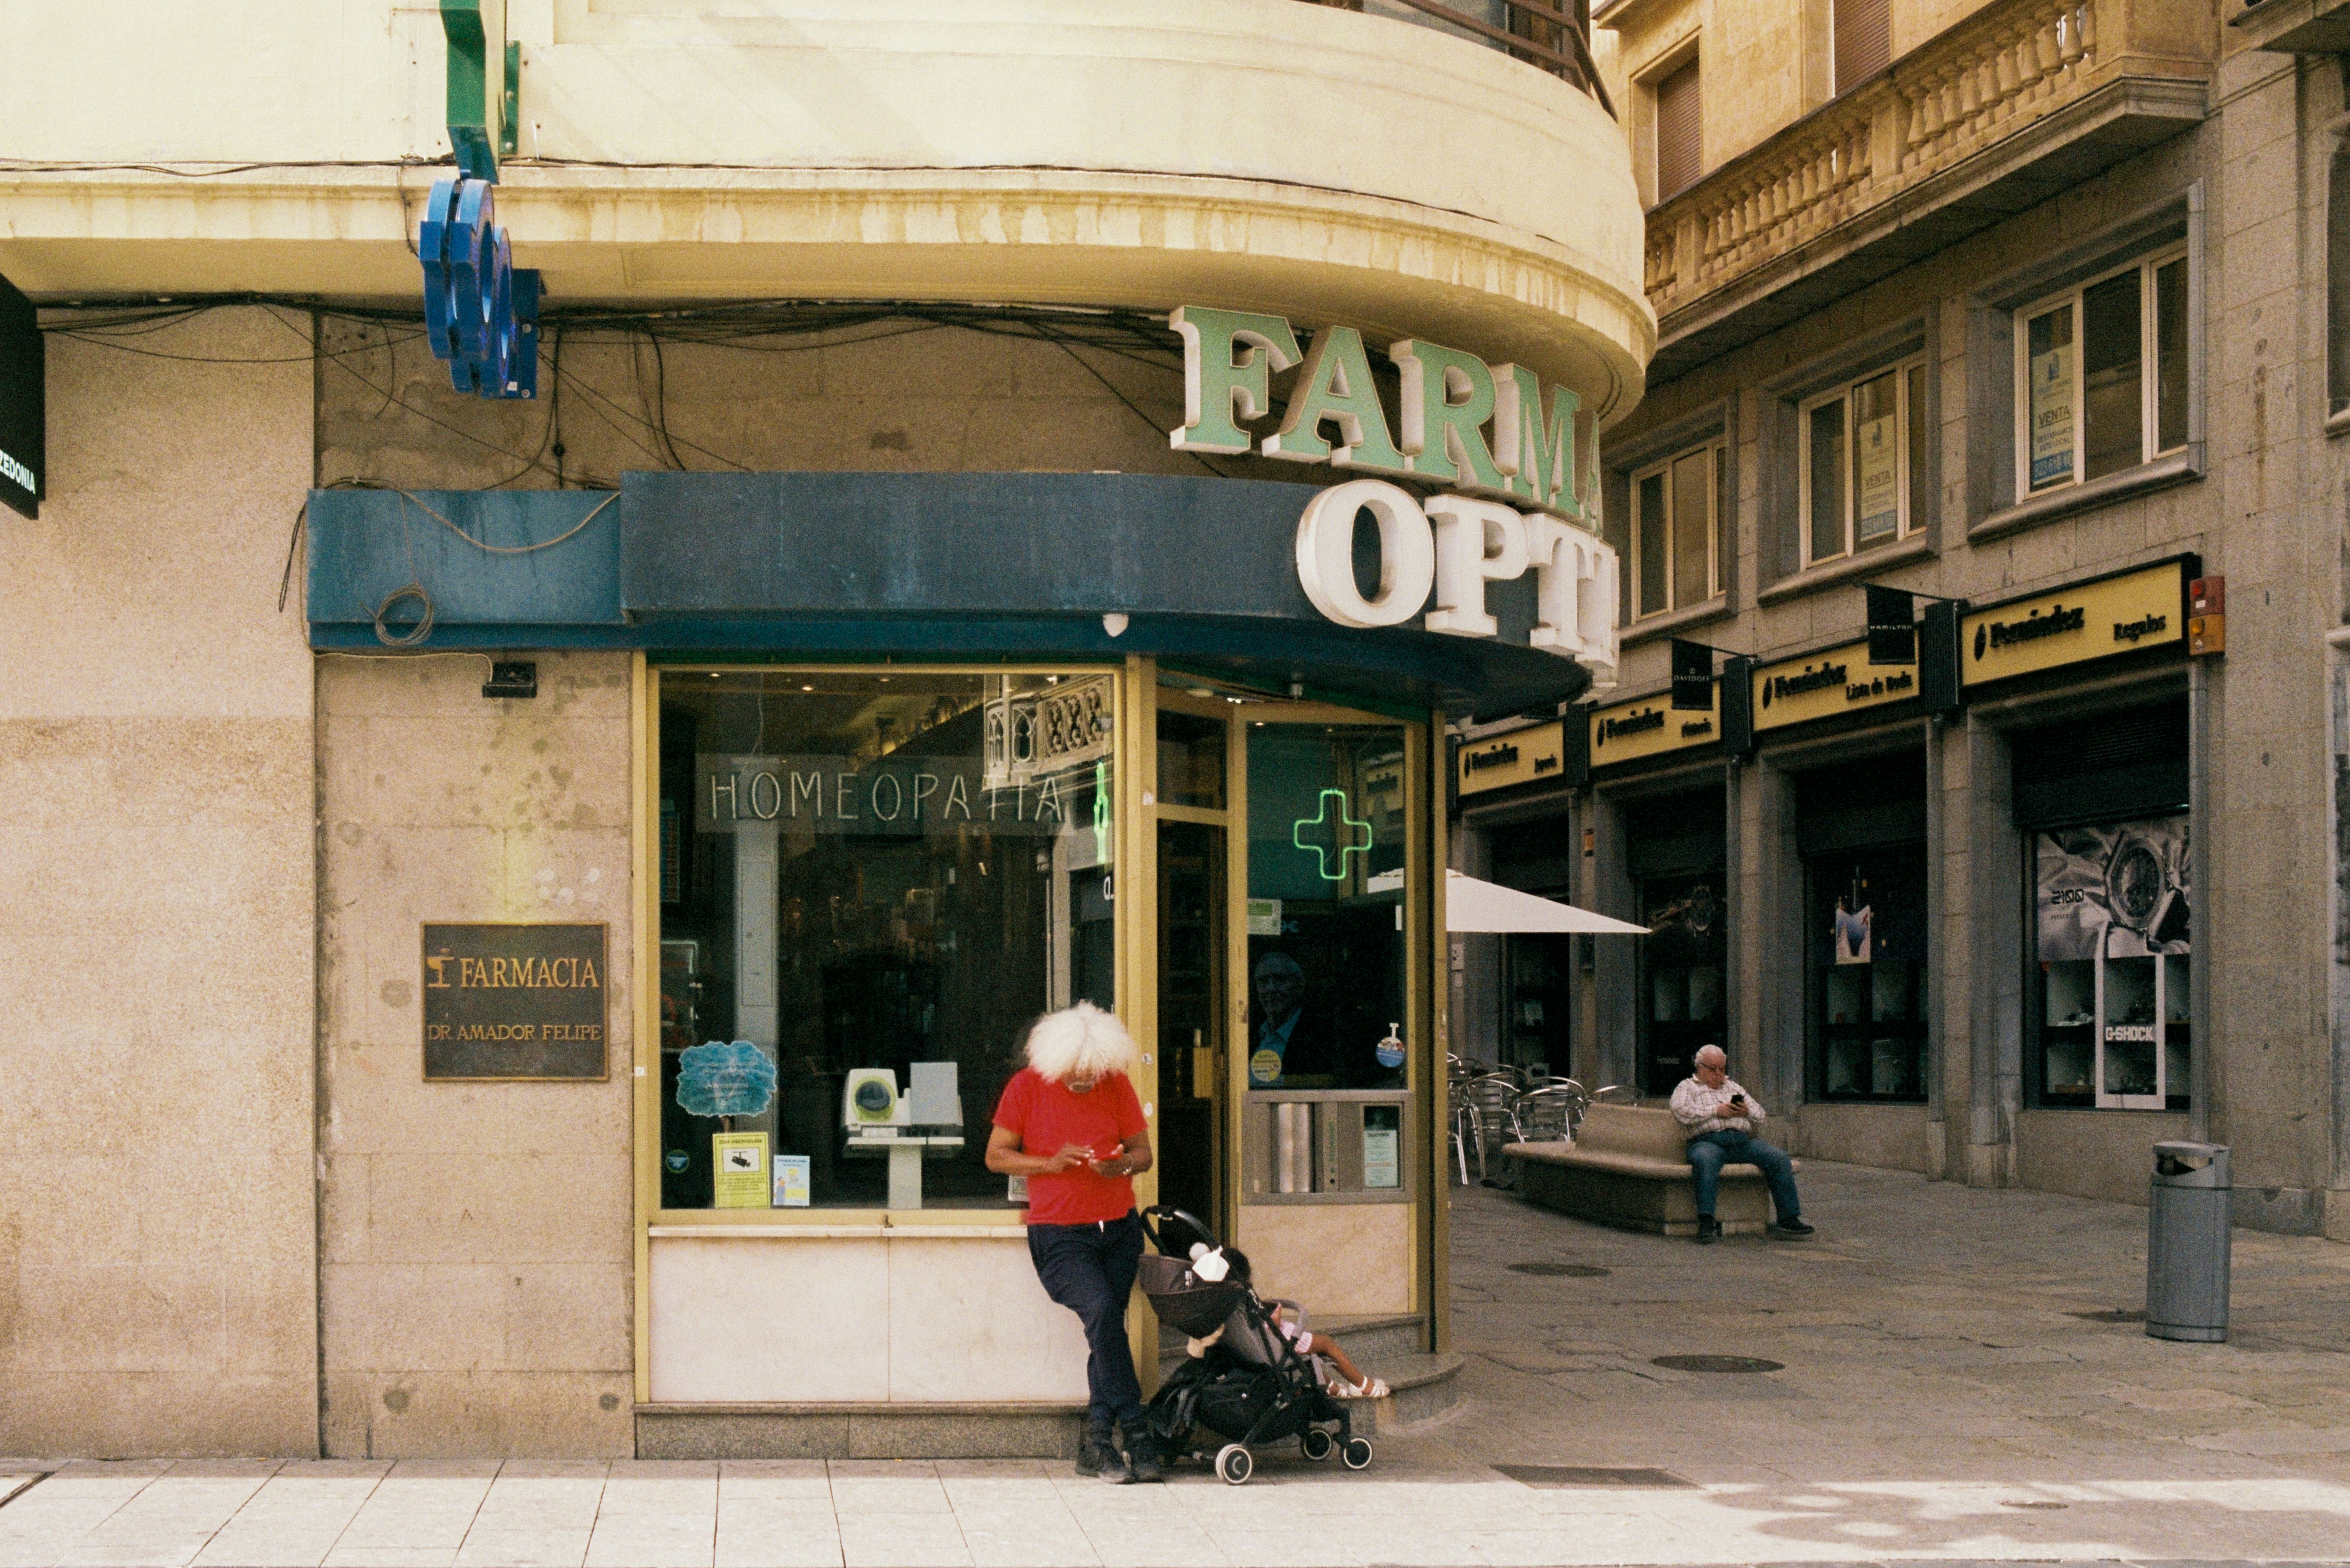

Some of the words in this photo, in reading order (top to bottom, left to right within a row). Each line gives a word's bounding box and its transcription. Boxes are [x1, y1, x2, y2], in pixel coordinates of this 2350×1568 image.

[2039, 405, 2070, 425] VENTA
[2114, 614, 2166, 641] Regalos
[1673, 674, 1710, 683] DAVIDOFF
[1872, 677, 1883, 694] de
[710, 771, 1064, 821] HOMEOPATIA
[2051, 889, 2084, 905] 2100
[459, 957, 600, 988] FARMACIA
[427, 1025, 451, 1040] DR
[456, 1025, 536, 1040] AMADOR
[542, 1025, 602, 1041] FELIPE
[2105, 1026, 2155, 1041] G-SHOCK
